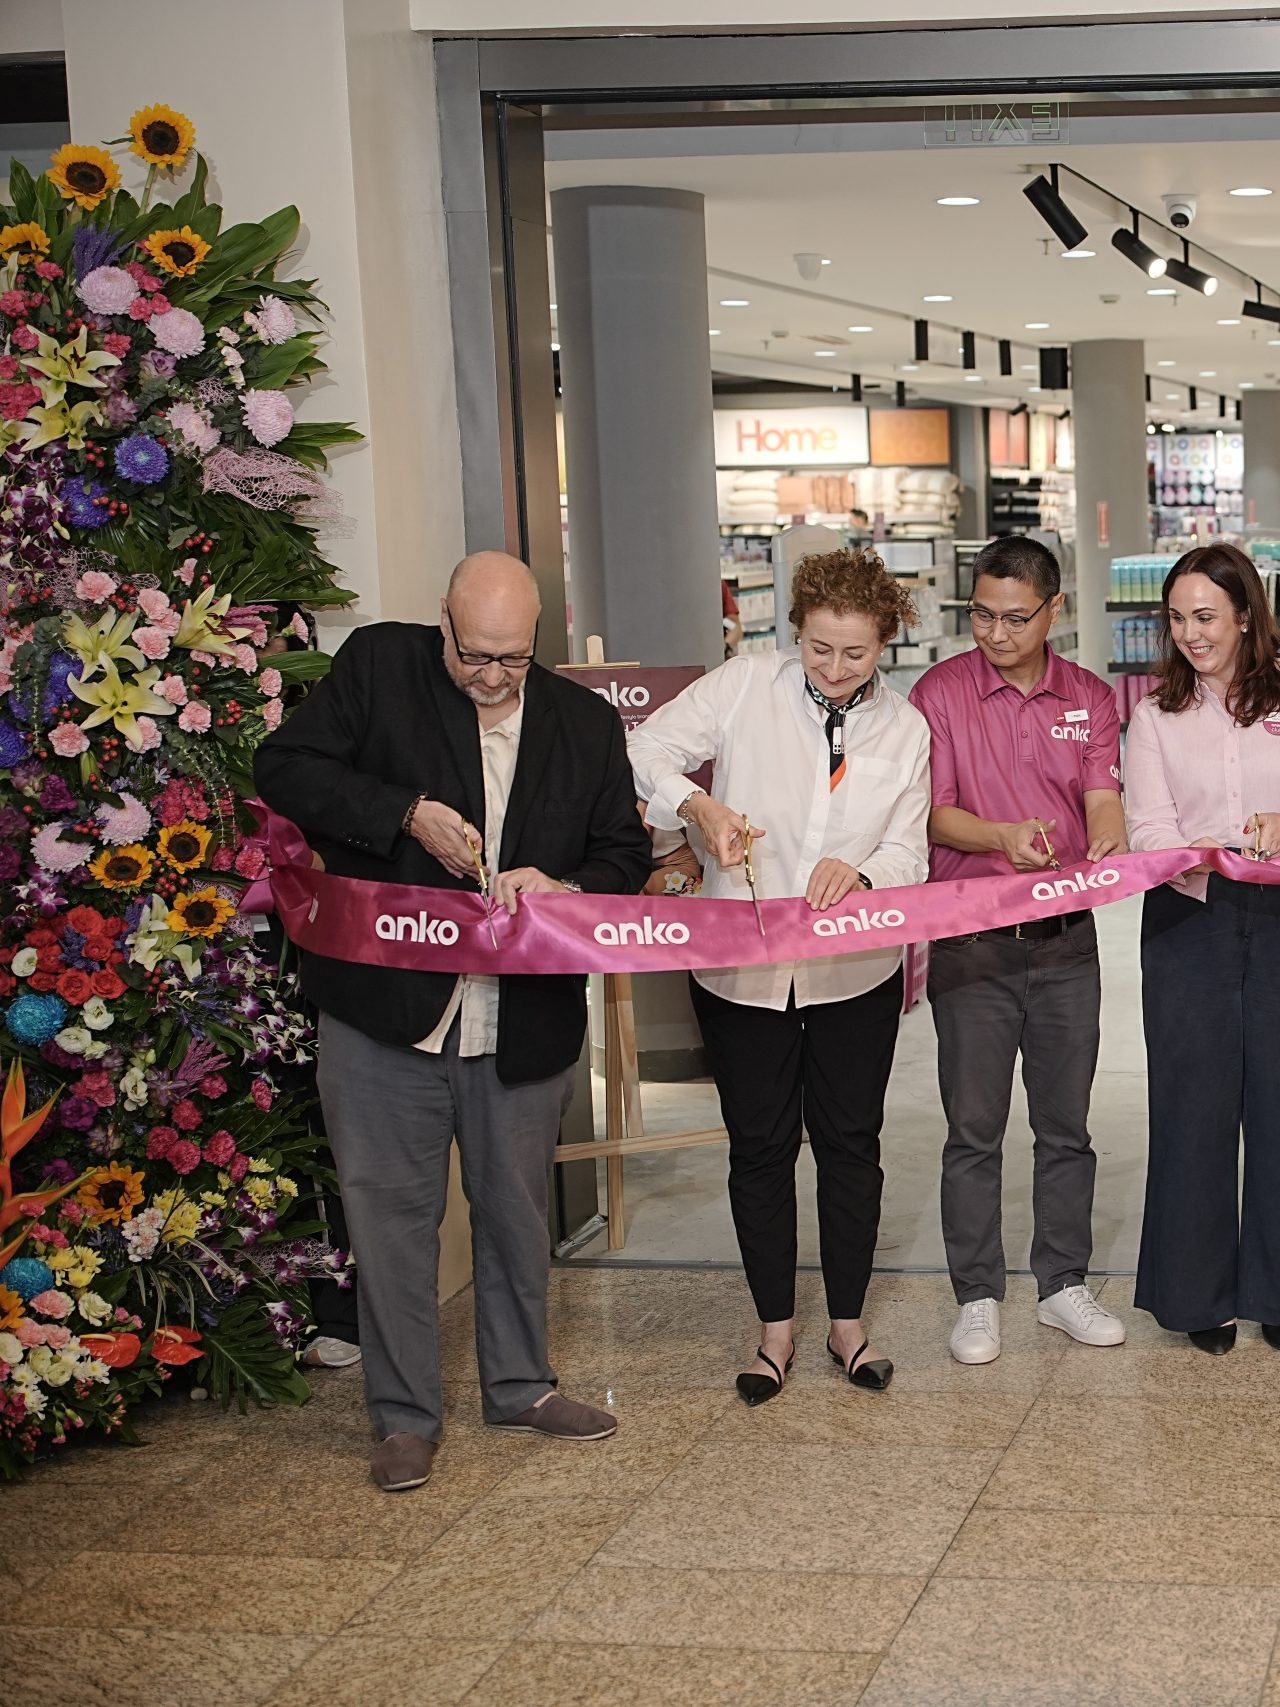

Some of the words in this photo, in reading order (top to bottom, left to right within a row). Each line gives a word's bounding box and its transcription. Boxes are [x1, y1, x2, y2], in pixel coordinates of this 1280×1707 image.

[736, 420, 838, 452] Home
[1031, 868, 1121, 901] anko
[375, 911, 460, 946] anko
[593, 916, 690, 945] anko
[813, 908, 905, 937] anko
